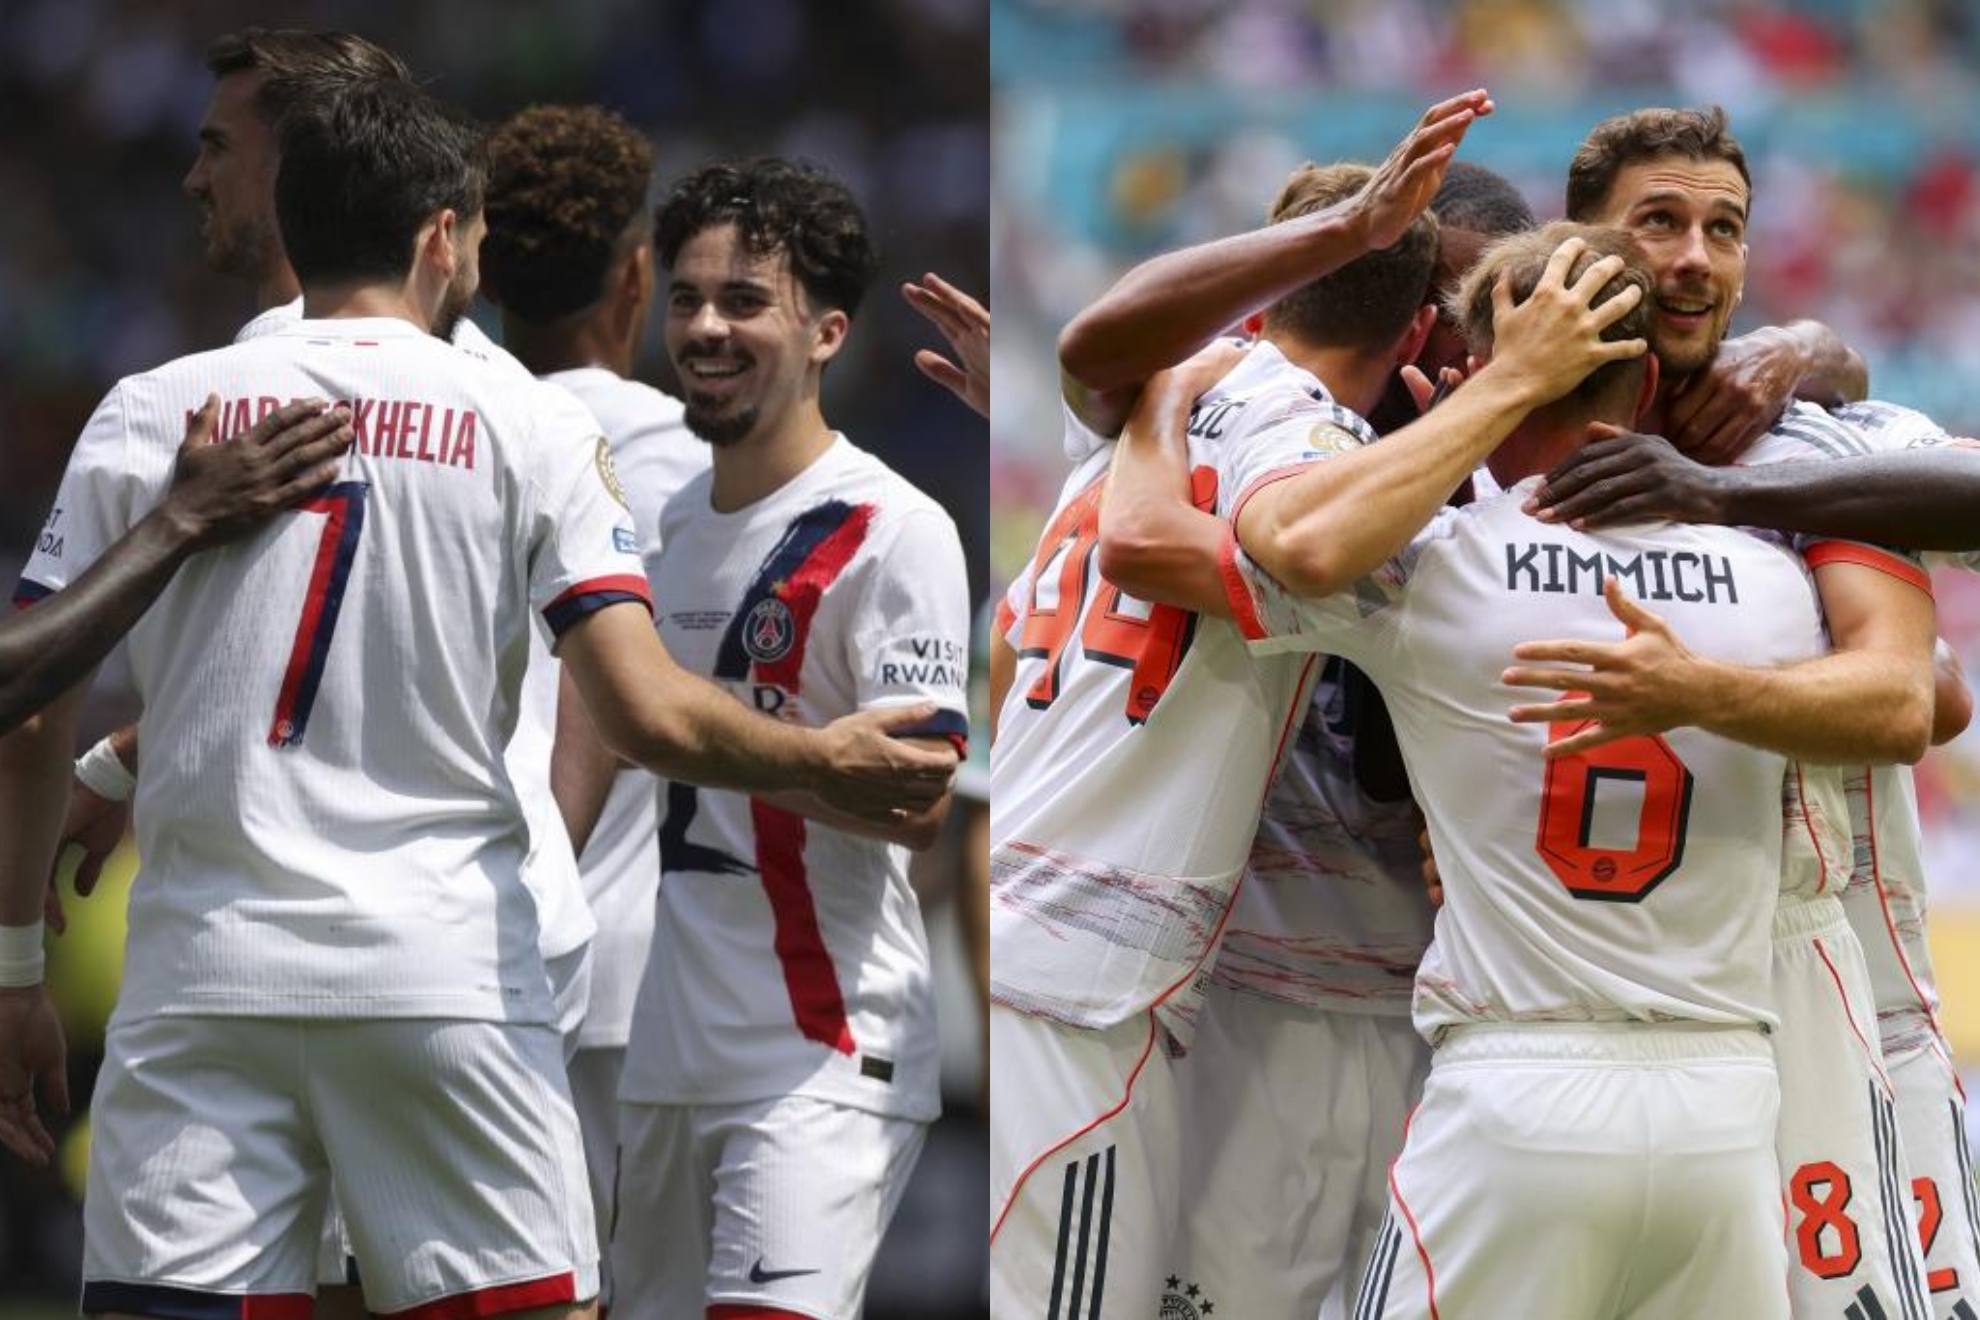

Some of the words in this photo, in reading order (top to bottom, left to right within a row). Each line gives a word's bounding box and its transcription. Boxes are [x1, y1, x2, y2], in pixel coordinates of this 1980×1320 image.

[186, 397, 477, 469] VAKHELIA
[267, 481, 364, 749] 7
[1017, 464, 1218, 727] 44
[1505, 542, 1739, 604] KIMMICH
[882, 663, 967, 689] RWAN
[1535, 624, 1694, 904] 6
[1789, 1160, 1863, 1281] 8
